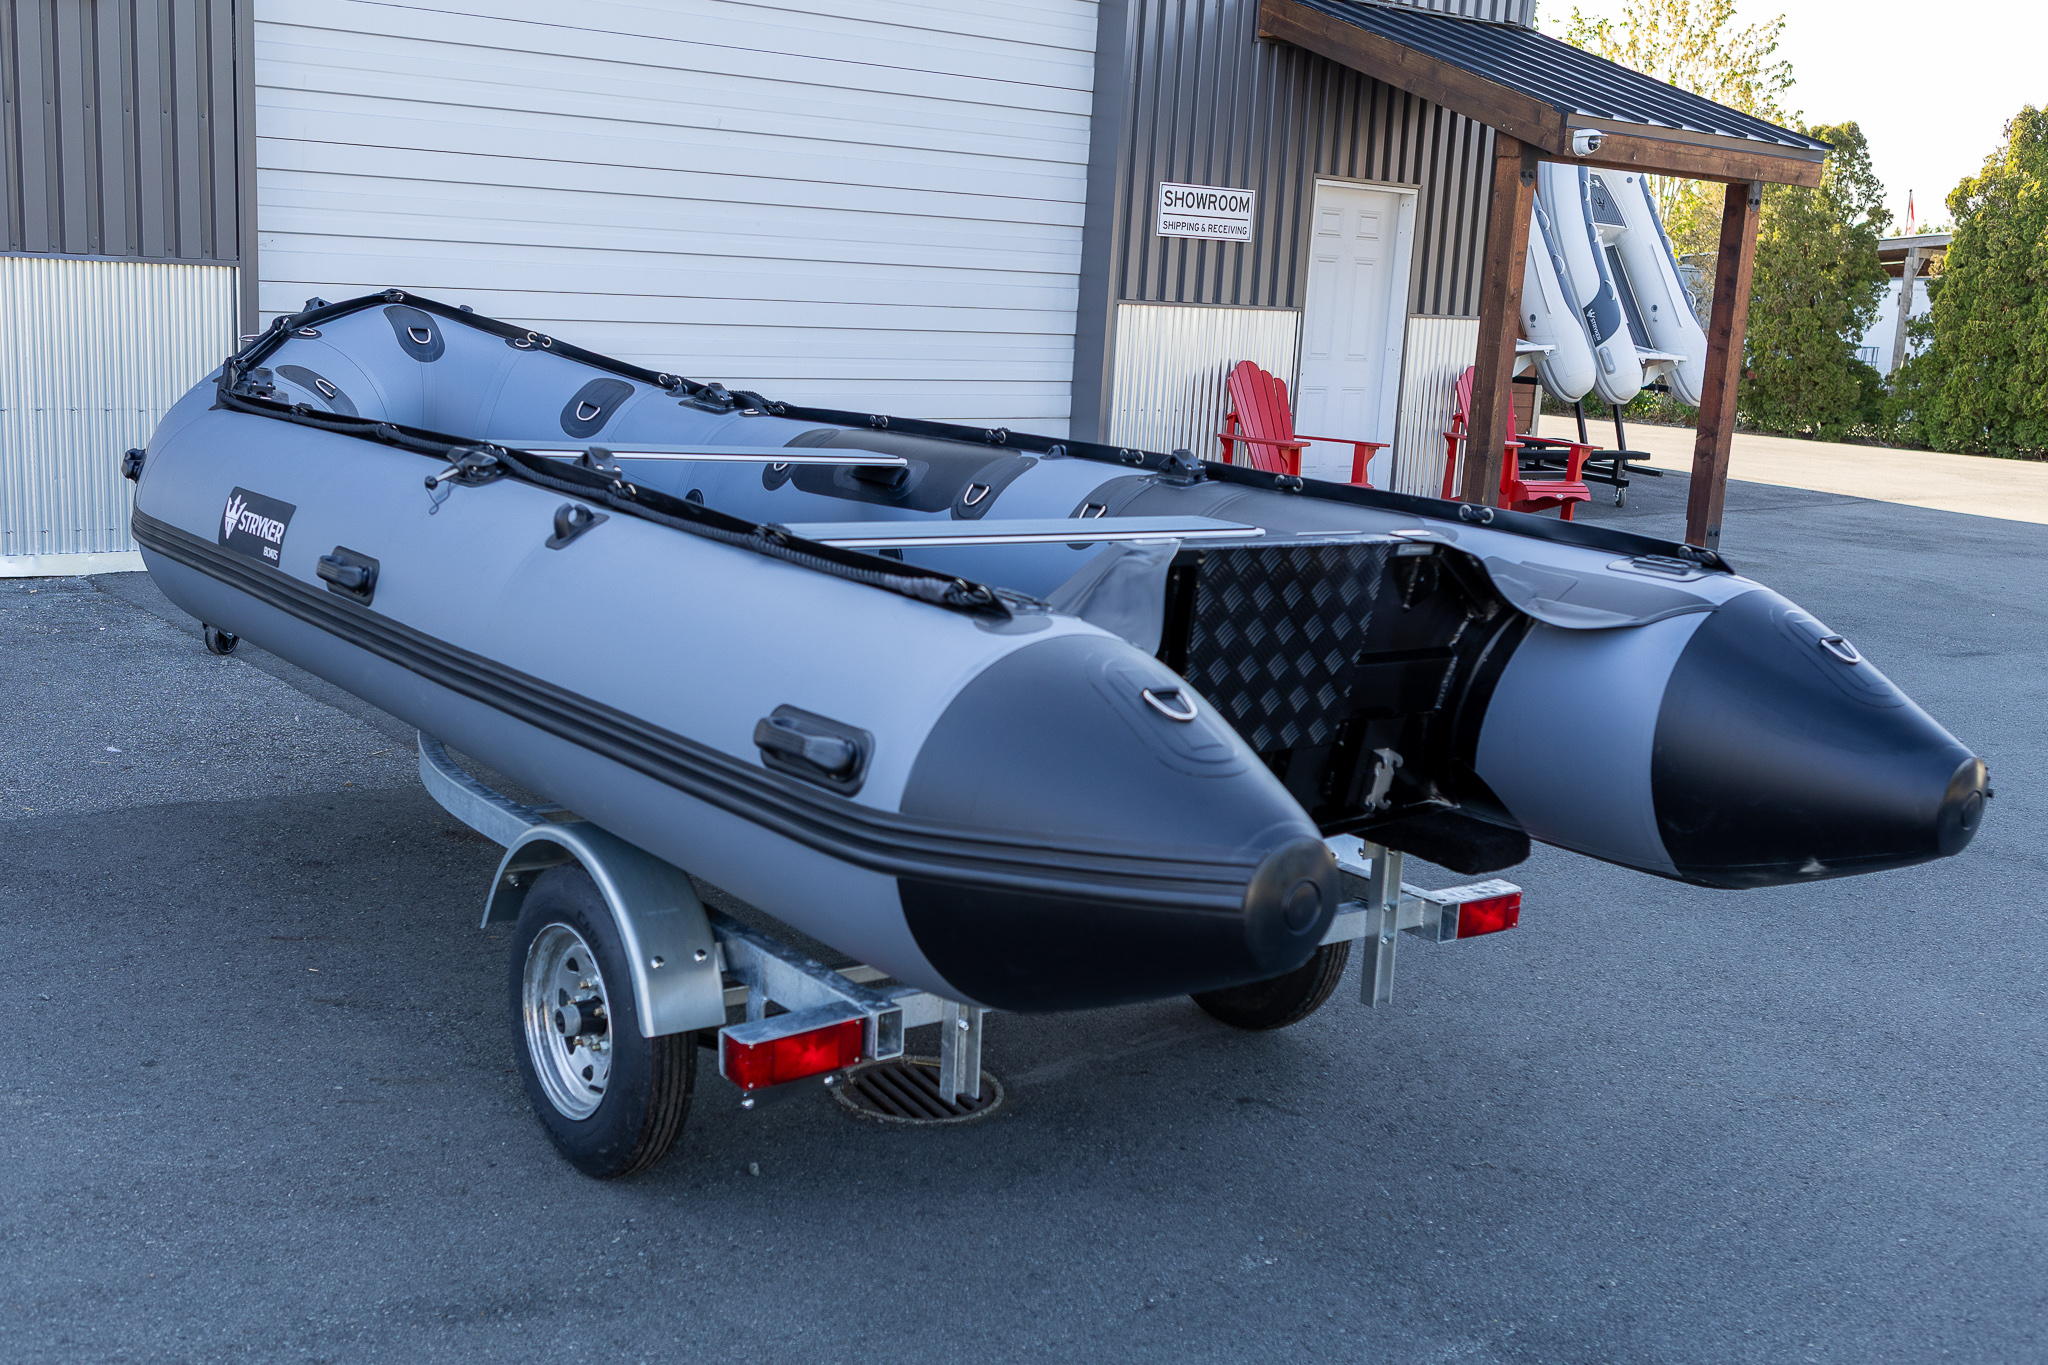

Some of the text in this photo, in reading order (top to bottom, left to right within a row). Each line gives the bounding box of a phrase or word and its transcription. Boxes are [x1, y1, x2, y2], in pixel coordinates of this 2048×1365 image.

[1163, 190, 1250, 213] SHOWROOM
[1162, 220, 1248, 236] SHIPPING & RECEIVING
[1590, 318, 1601, 340] STRYKER
[238, 510, 285, 545] STRYKER
[263, 546, 279, 561] BOATS
